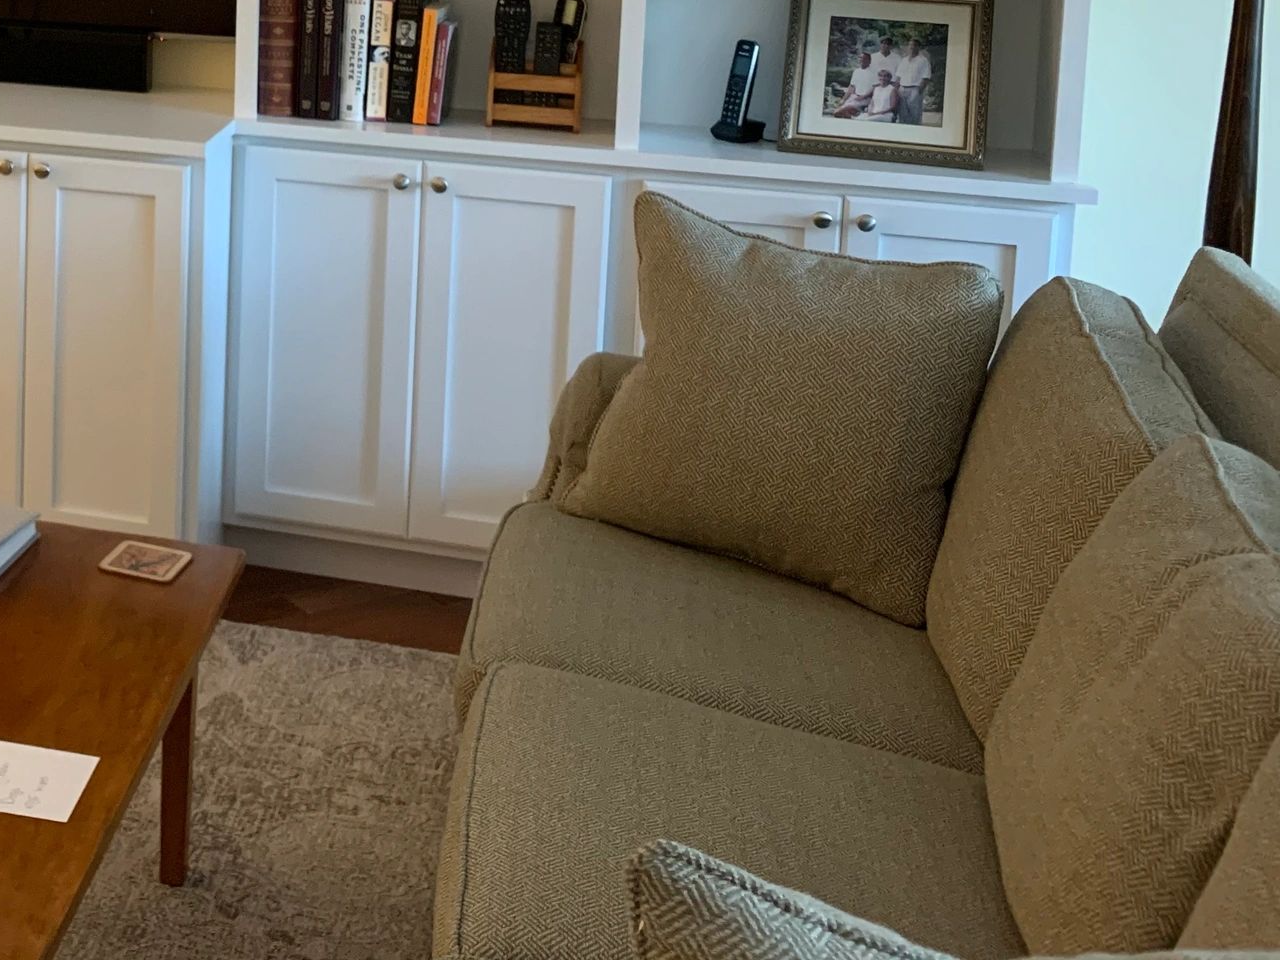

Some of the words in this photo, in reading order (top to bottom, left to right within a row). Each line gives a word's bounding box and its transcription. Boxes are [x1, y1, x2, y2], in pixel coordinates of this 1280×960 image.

[373, 4, 382, 42] KEEGAN
[348, 28, 357, 80] COMPLETE
[355, 38, 364, 96] PALESTINE,
